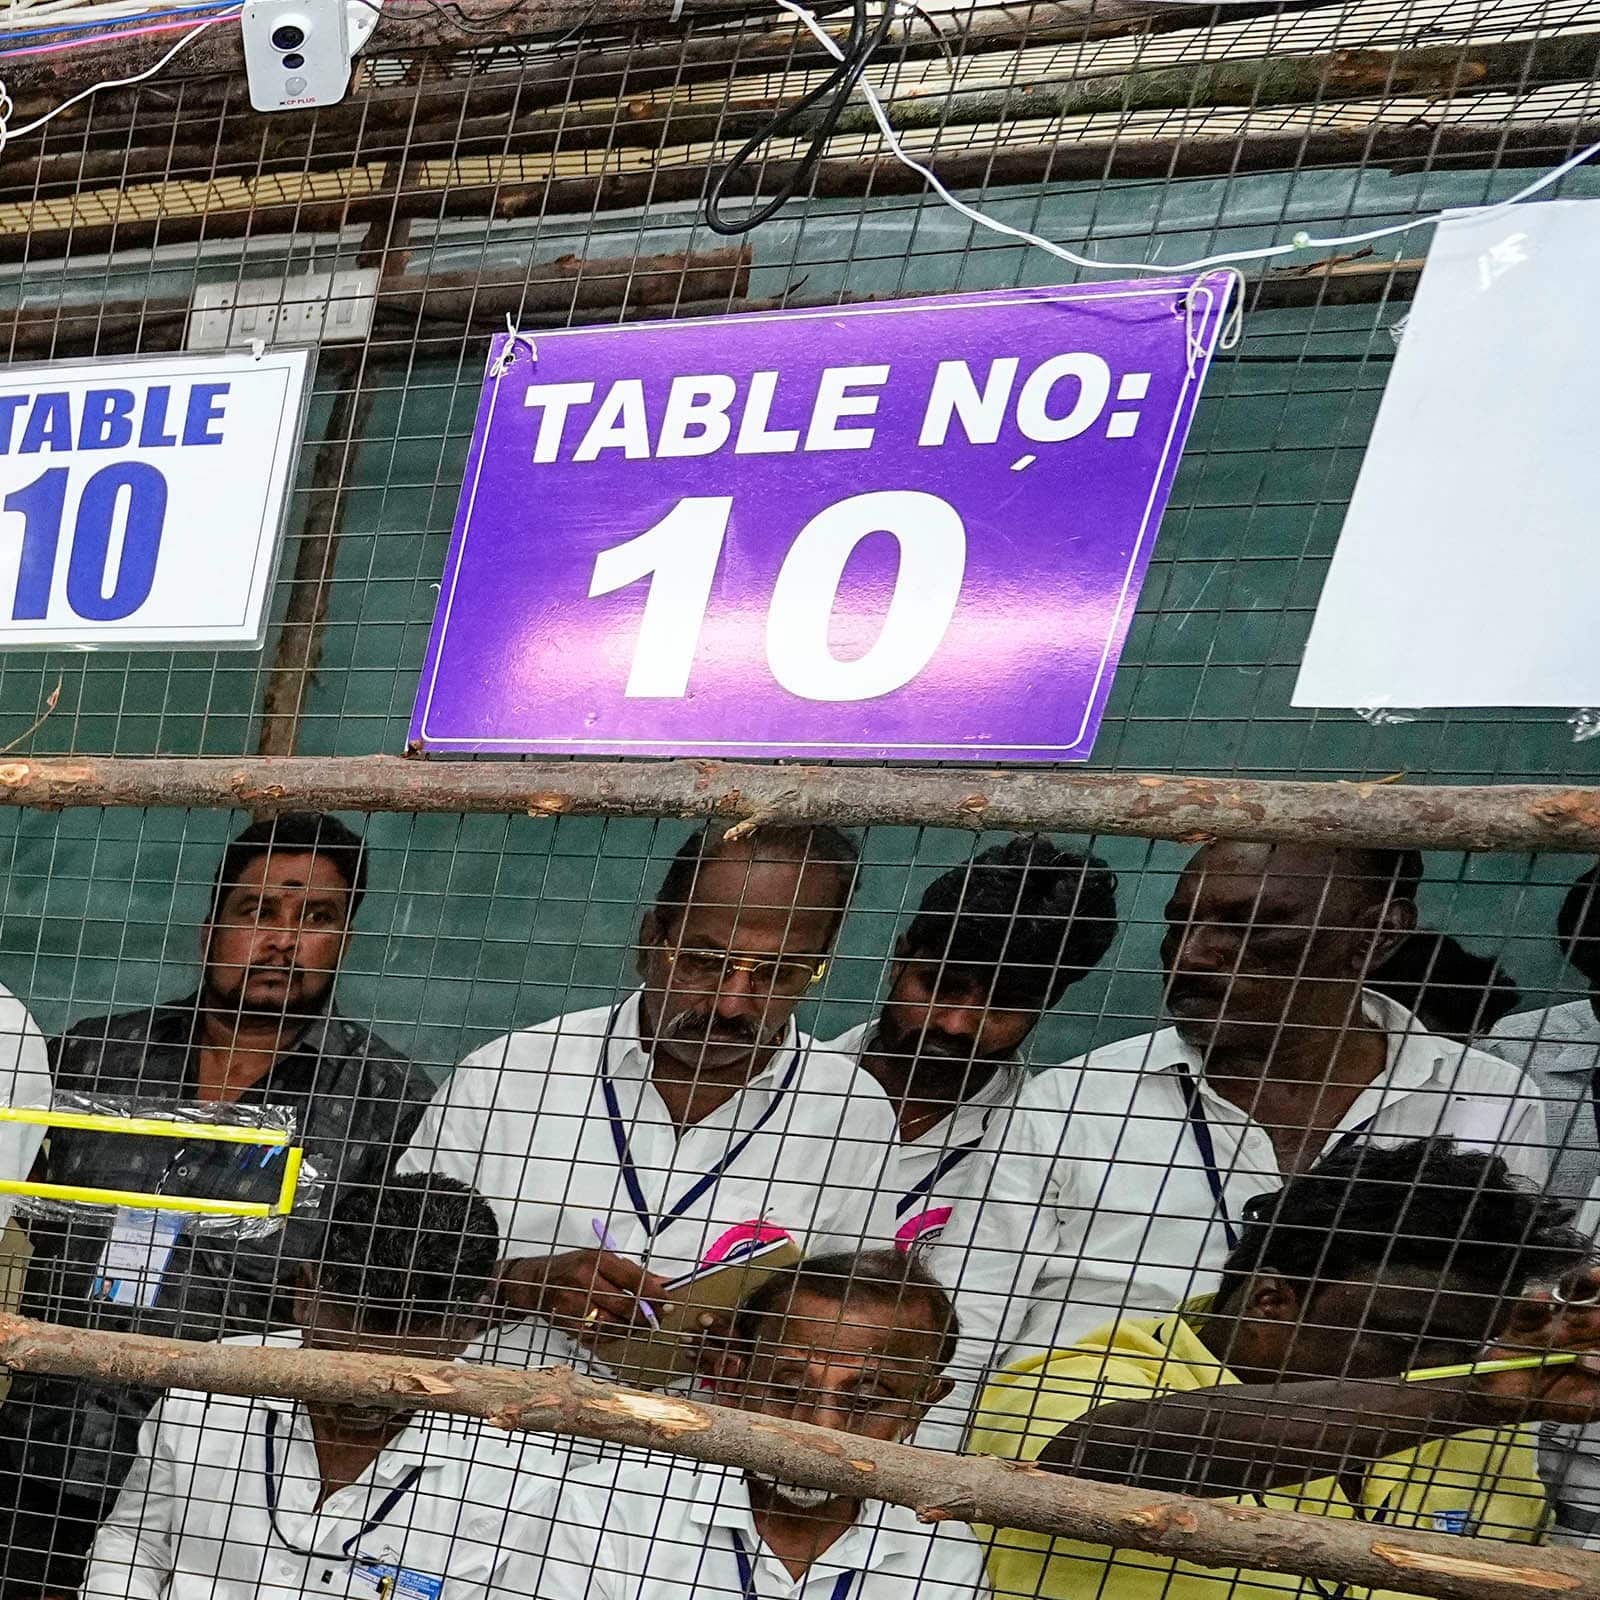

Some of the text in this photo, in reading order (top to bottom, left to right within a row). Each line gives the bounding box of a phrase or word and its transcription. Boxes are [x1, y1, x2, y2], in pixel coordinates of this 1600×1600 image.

[297, 97, 316, 105] PLUS
[523, 351, 1150, 464] TABLE NO:
[3, 460, 169, 622] 10
[588, 489, 968, 703] 10
